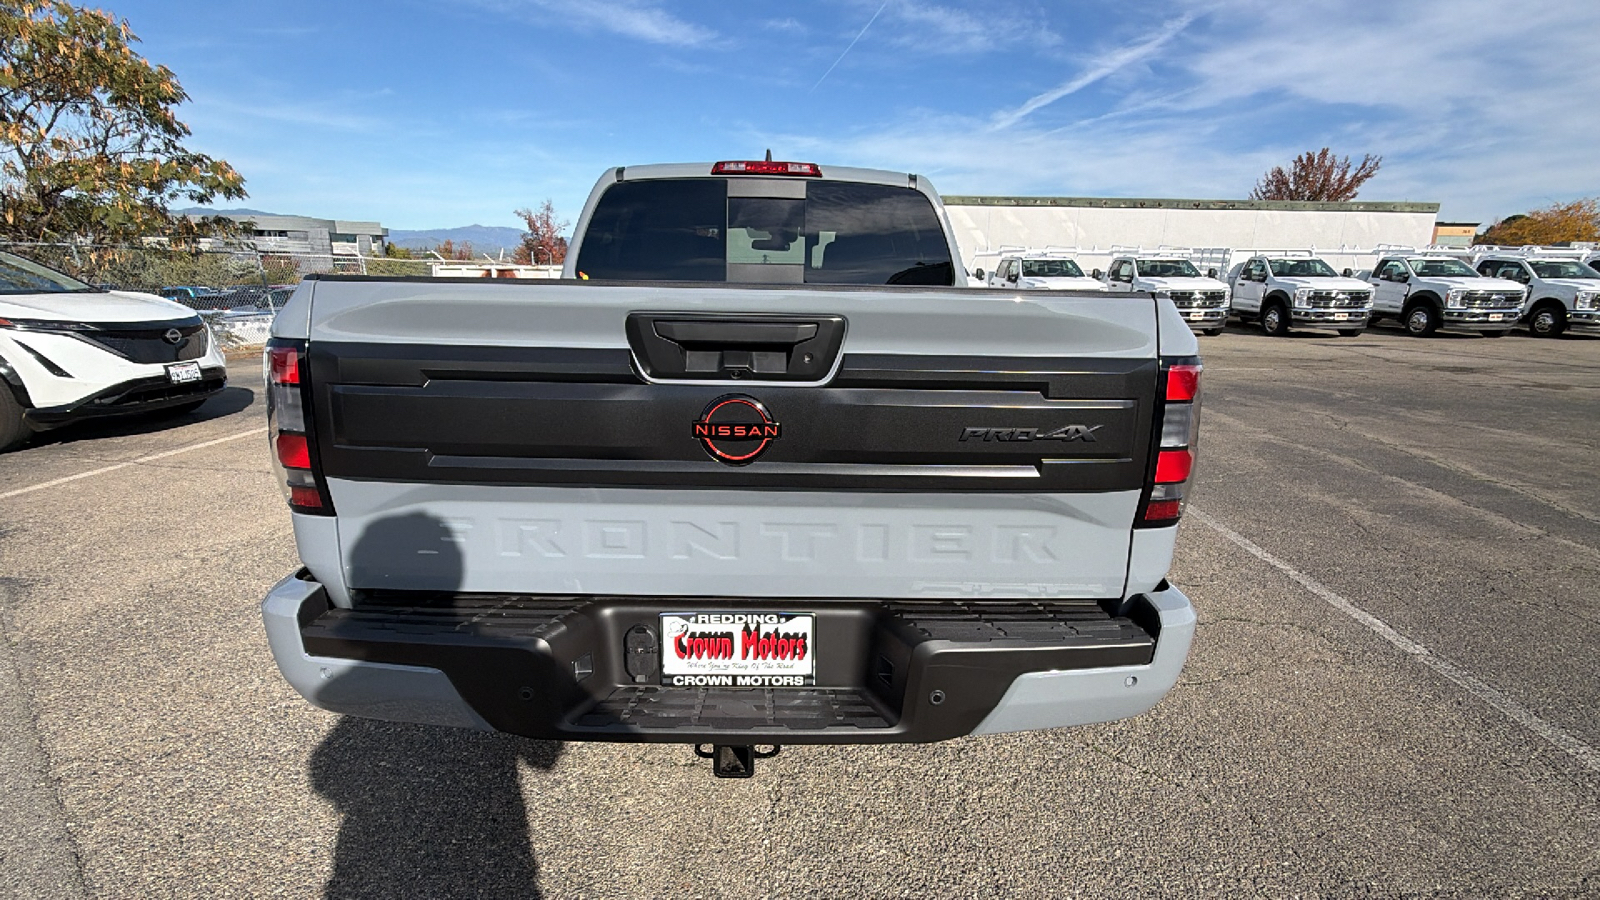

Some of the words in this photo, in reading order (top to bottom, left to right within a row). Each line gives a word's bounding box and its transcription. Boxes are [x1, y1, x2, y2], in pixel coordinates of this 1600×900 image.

[695, 424, 778, 436] NISSAN
[958, 424, 1104, 442] PRO-4X
[417, 515, 1060, 564] FRONTIER
[697, 614, 778, 624] REDDING
[674, 629, 734, 660] Crown
[741, 624, 807, 660] Motors
[673, 676, 732, 686] CROWN
[737, 676, 804, 686] MOTORS
